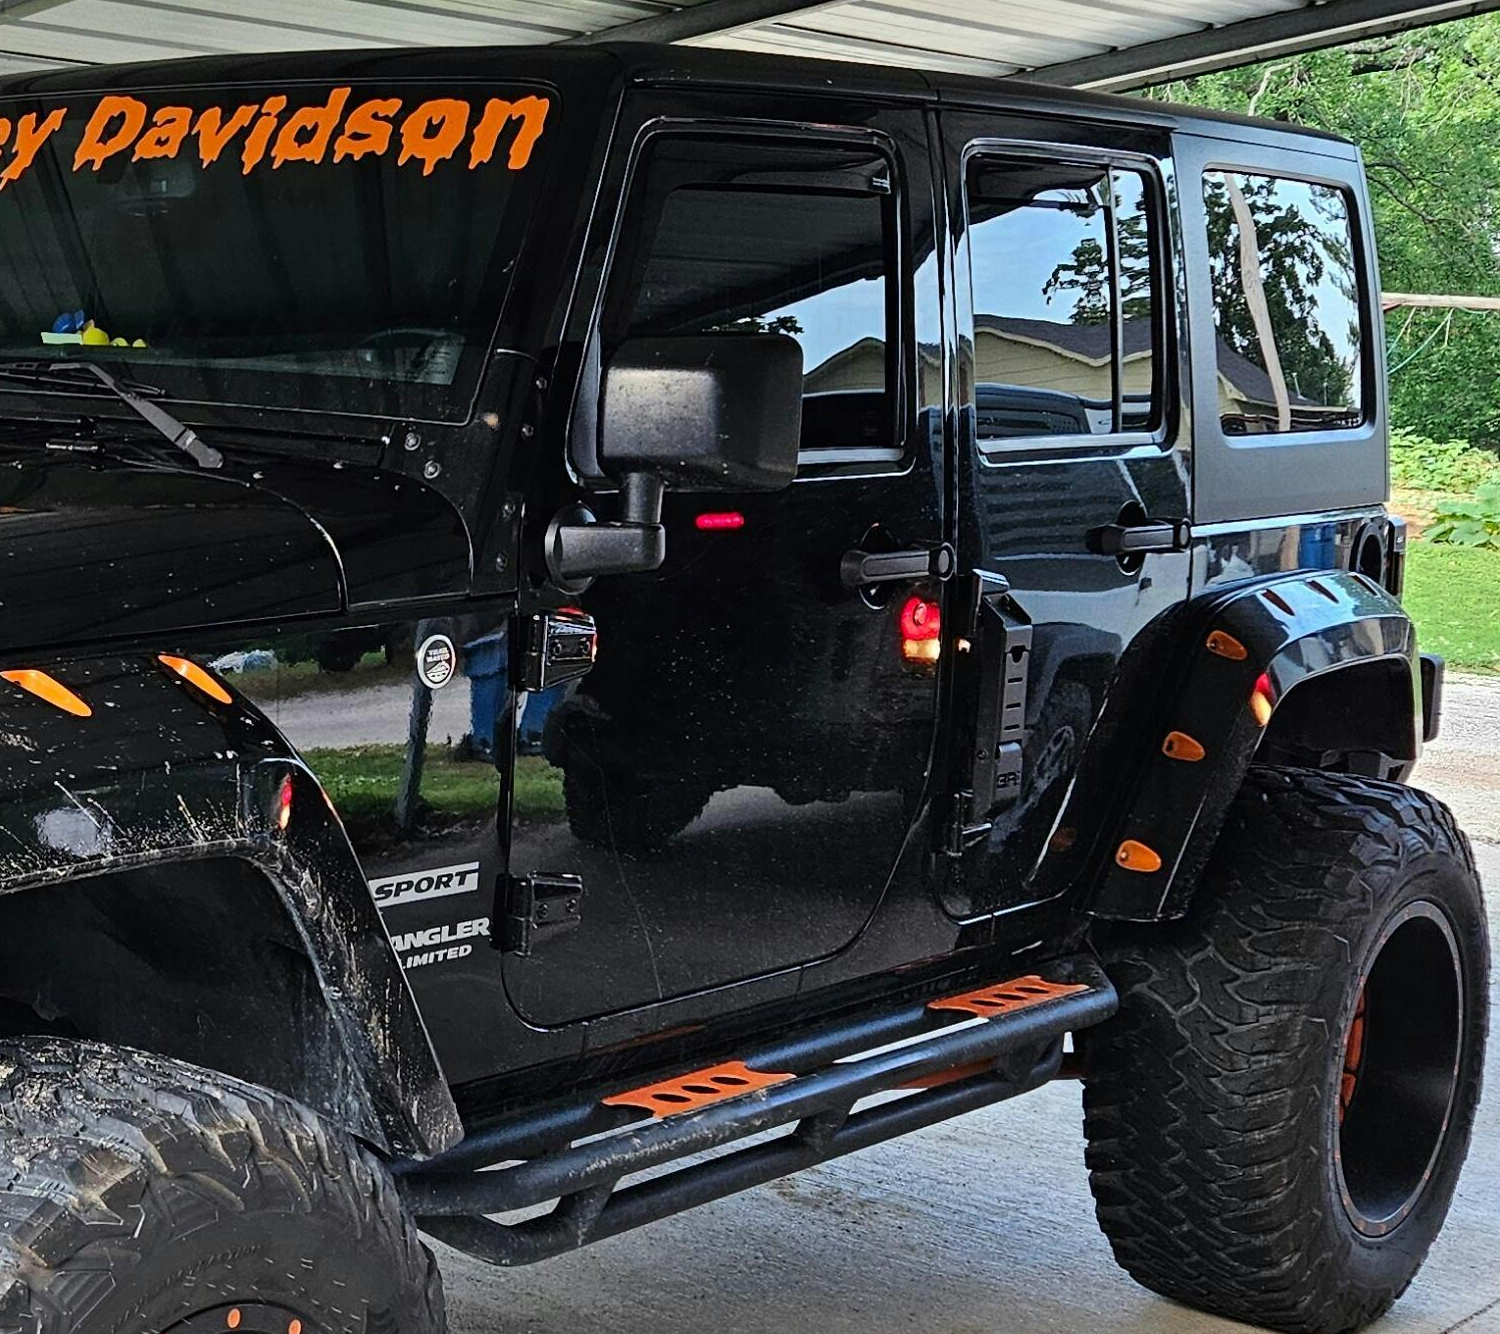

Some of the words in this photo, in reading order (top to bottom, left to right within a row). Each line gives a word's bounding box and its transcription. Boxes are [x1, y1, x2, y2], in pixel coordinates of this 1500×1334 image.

[74, 86, 550, 176] Davidson
[373, 868, 479, 902] SPORT
[400, 944, 473, 970] IMITED
